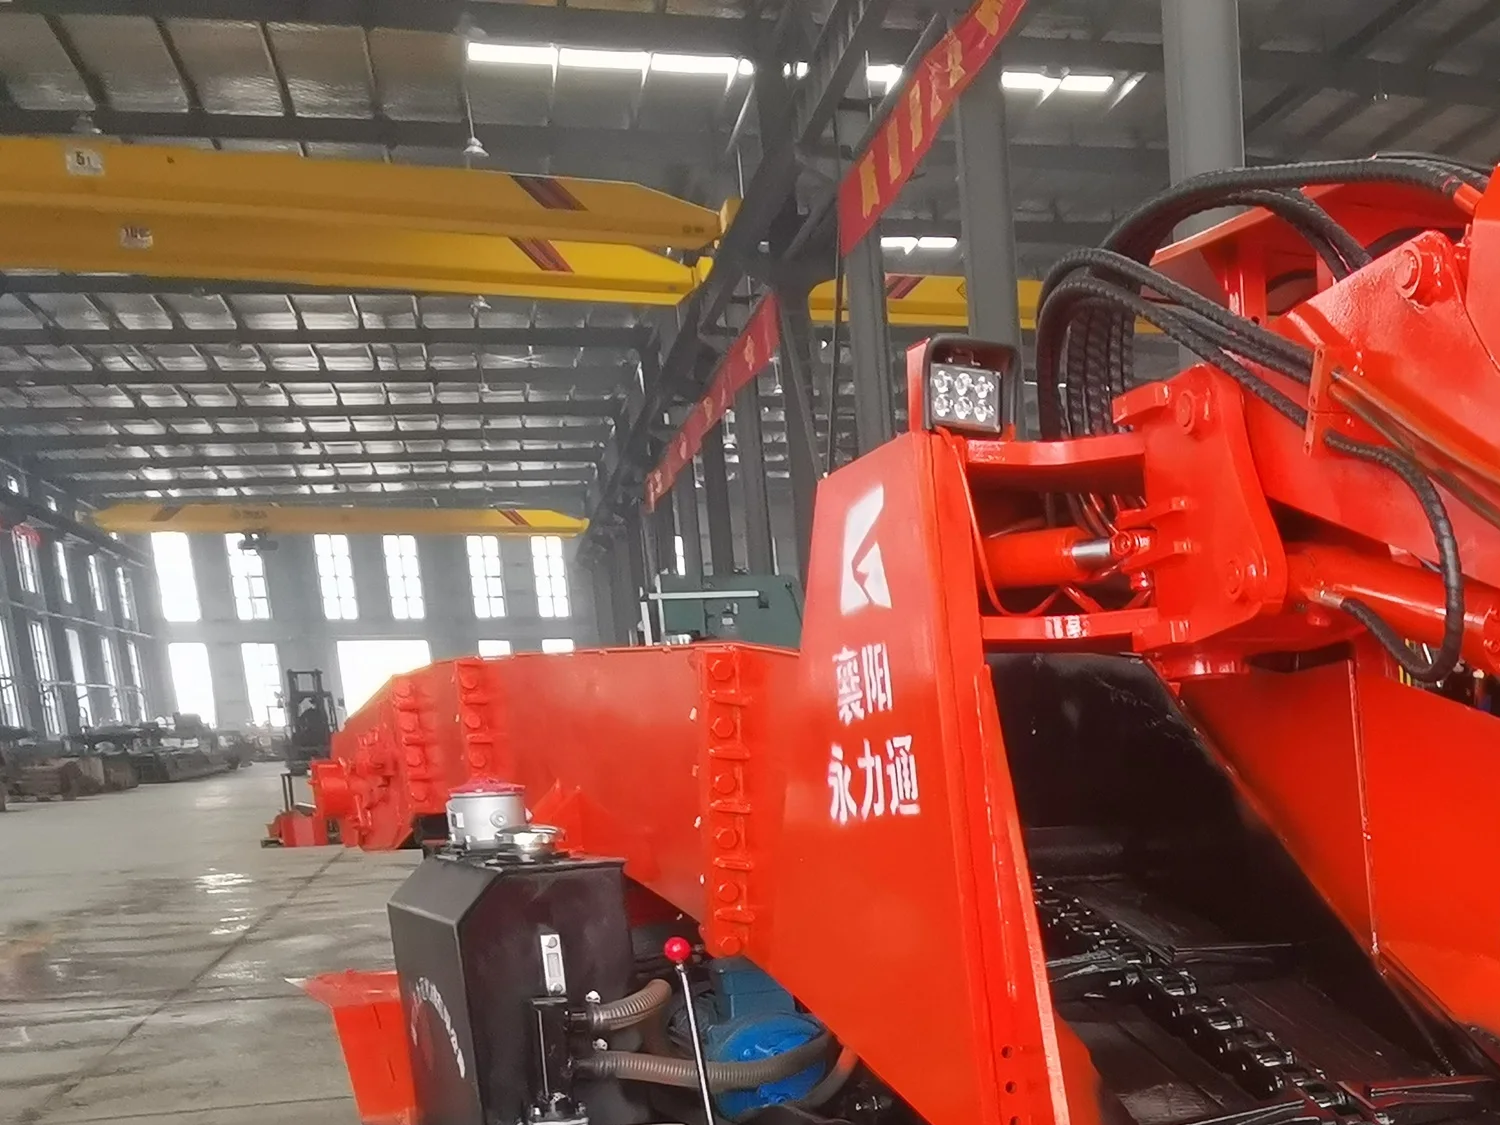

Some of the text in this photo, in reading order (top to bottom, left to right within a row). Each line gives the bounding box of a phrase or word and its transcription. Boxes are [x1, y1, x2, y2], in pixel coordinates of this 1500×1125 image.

[832, 642, 893, 725] 襄阳
[828, 735, 920, 826] 永力通
